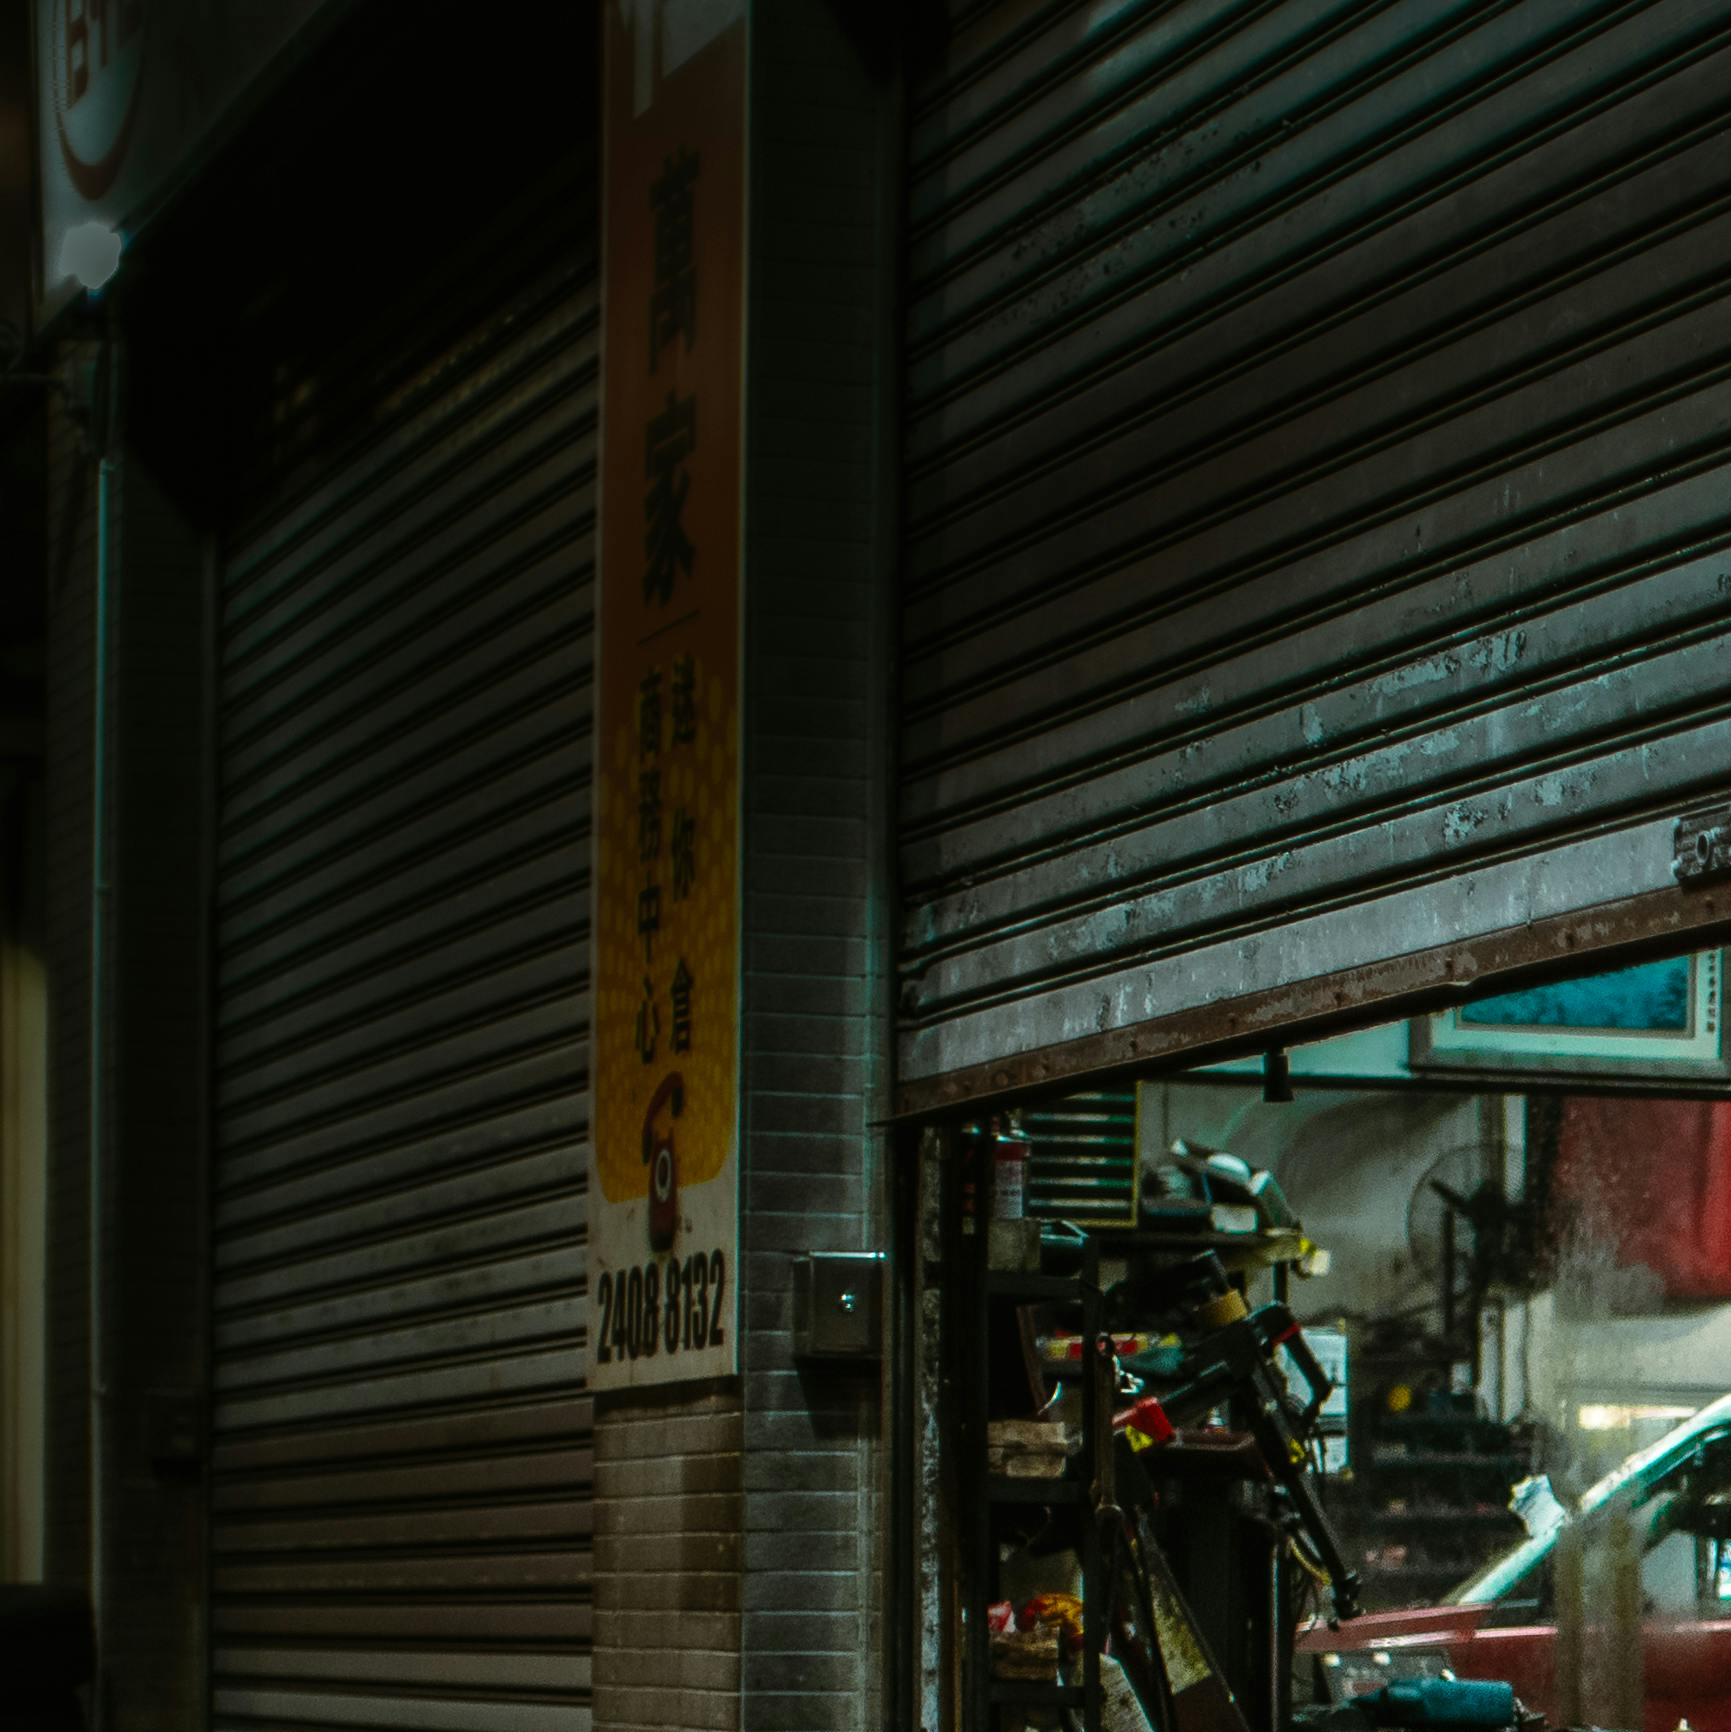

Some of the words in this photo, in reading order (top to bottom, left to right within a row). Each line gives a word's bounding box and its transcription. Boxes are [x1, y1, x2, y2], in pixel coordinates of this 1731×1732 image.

[636, 664, 662, 1065] 商務中心
[671, 650, 695, 1054] 迷你倉
[598, 1262, 660, 1363] 2408
[665, 1249, 724, 1354] 8132
